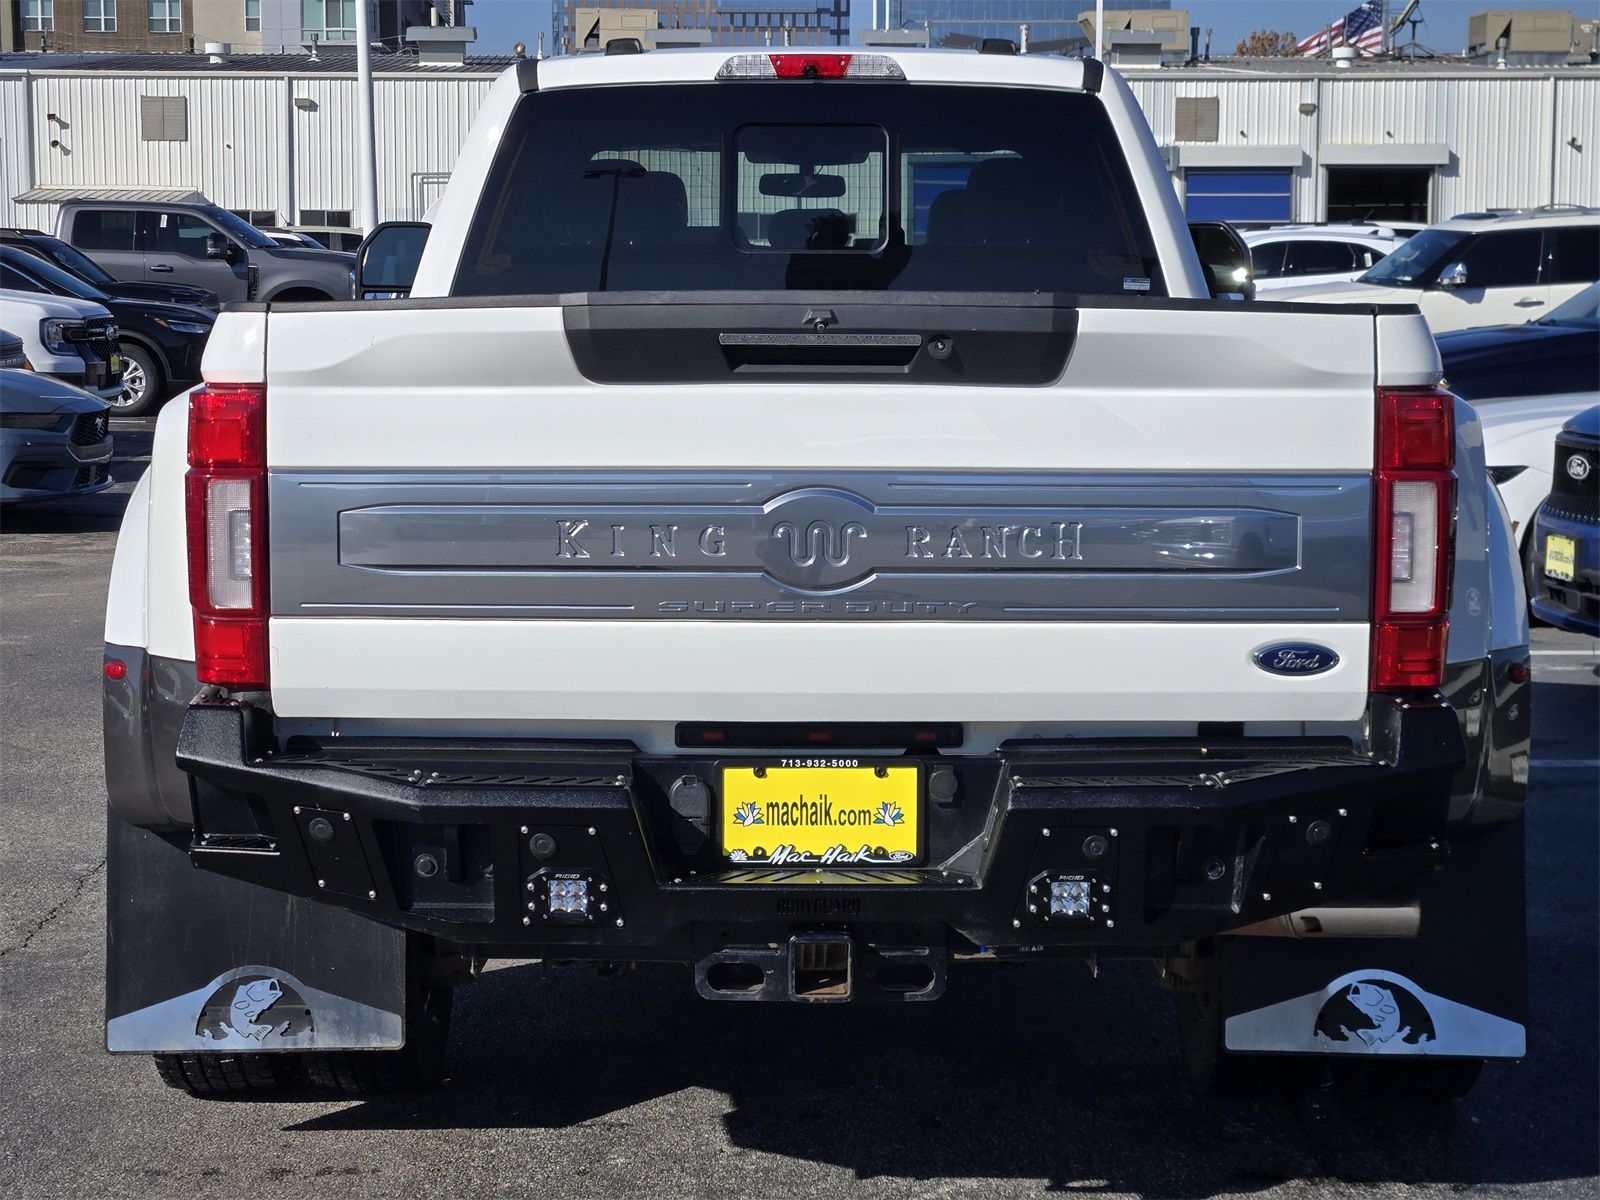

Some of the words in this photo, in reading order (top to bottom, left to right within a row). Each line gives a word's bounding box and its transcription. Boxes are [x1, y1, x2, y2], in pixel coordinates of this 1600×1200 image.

[556, 519, 726, 558] KING
[904, 521, 1083, 560] RANCH
[658, 600, 832, 614] SUPER
[846, 600, 977, 614] DUTY
[1273, 649, 1320, 669] Ford
[781, 759, 859, 768] 713-932-5000
[766, 794, 872, 827] machaik.com
[769, 844, 819, 865] Mac
[820, 844, 878, 865] Haik
[776, 897, 861, 915] BODYGUARD
